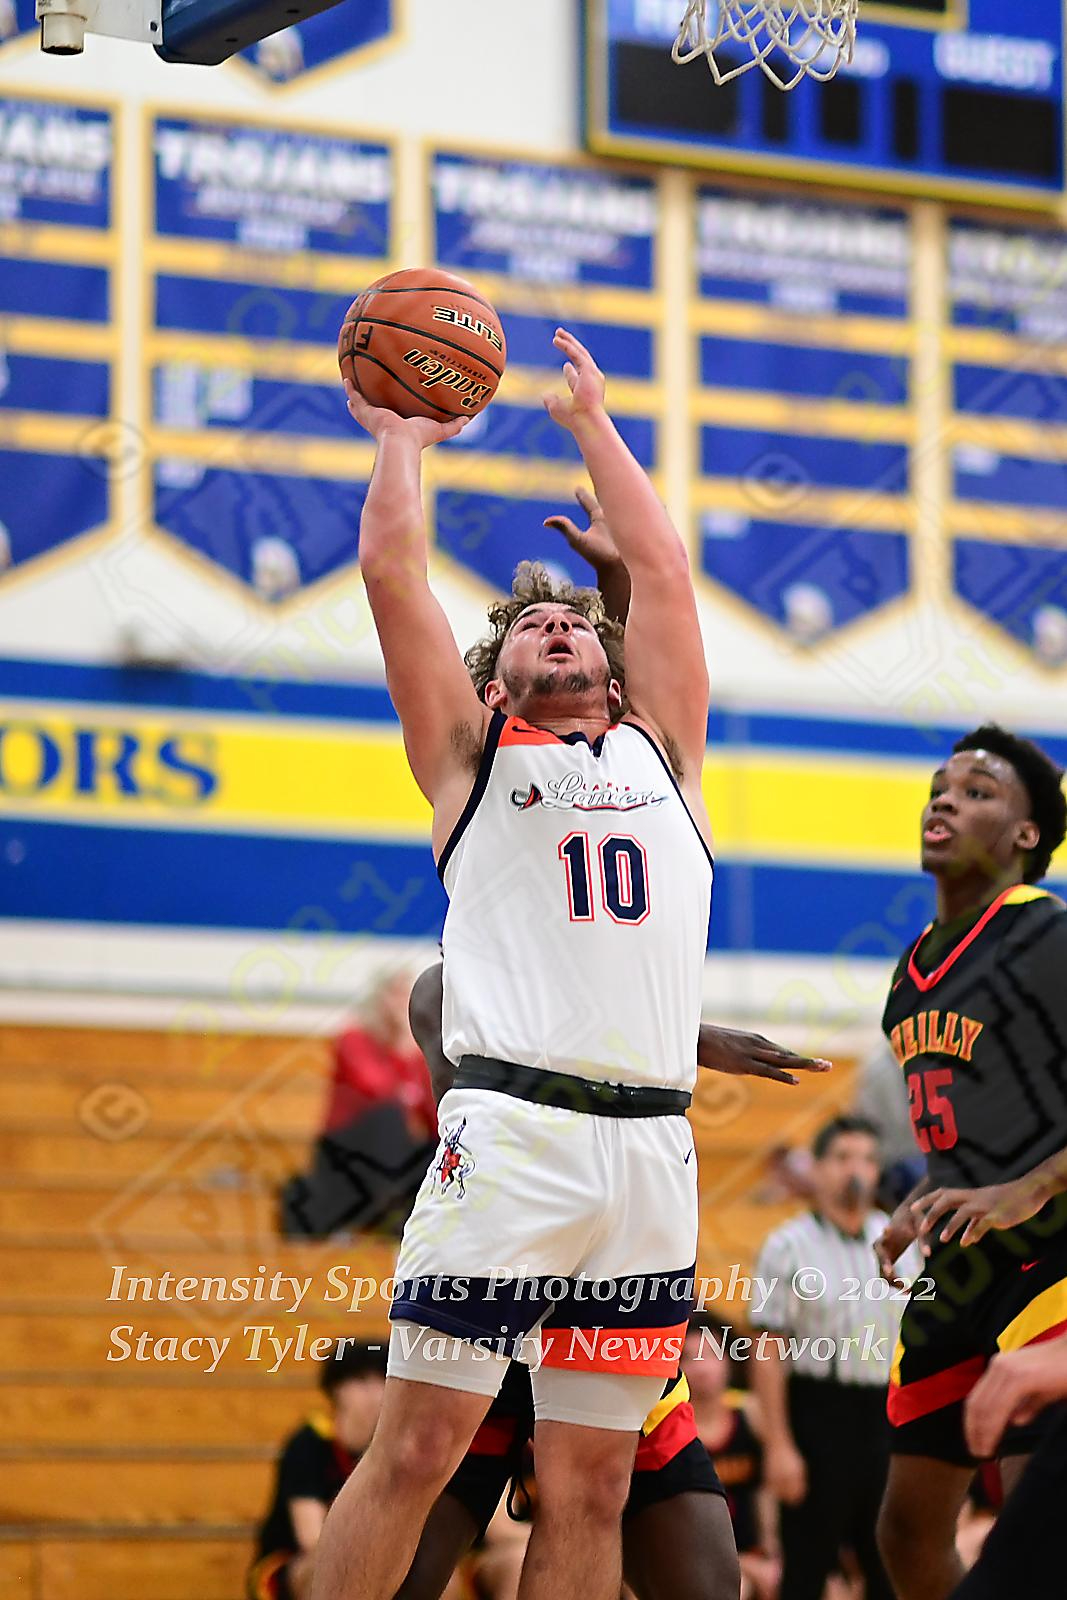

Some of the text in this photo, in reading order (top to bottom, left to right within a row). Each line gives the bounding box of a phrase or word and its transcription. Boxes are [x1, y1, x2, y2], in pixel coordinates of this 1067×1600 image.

[432, 305, 502, 352] ELITE
[401, 348, 492, 410] Baden
[557, 831, 652, 926] 10
[907, 1067, 959, 1154] 25
